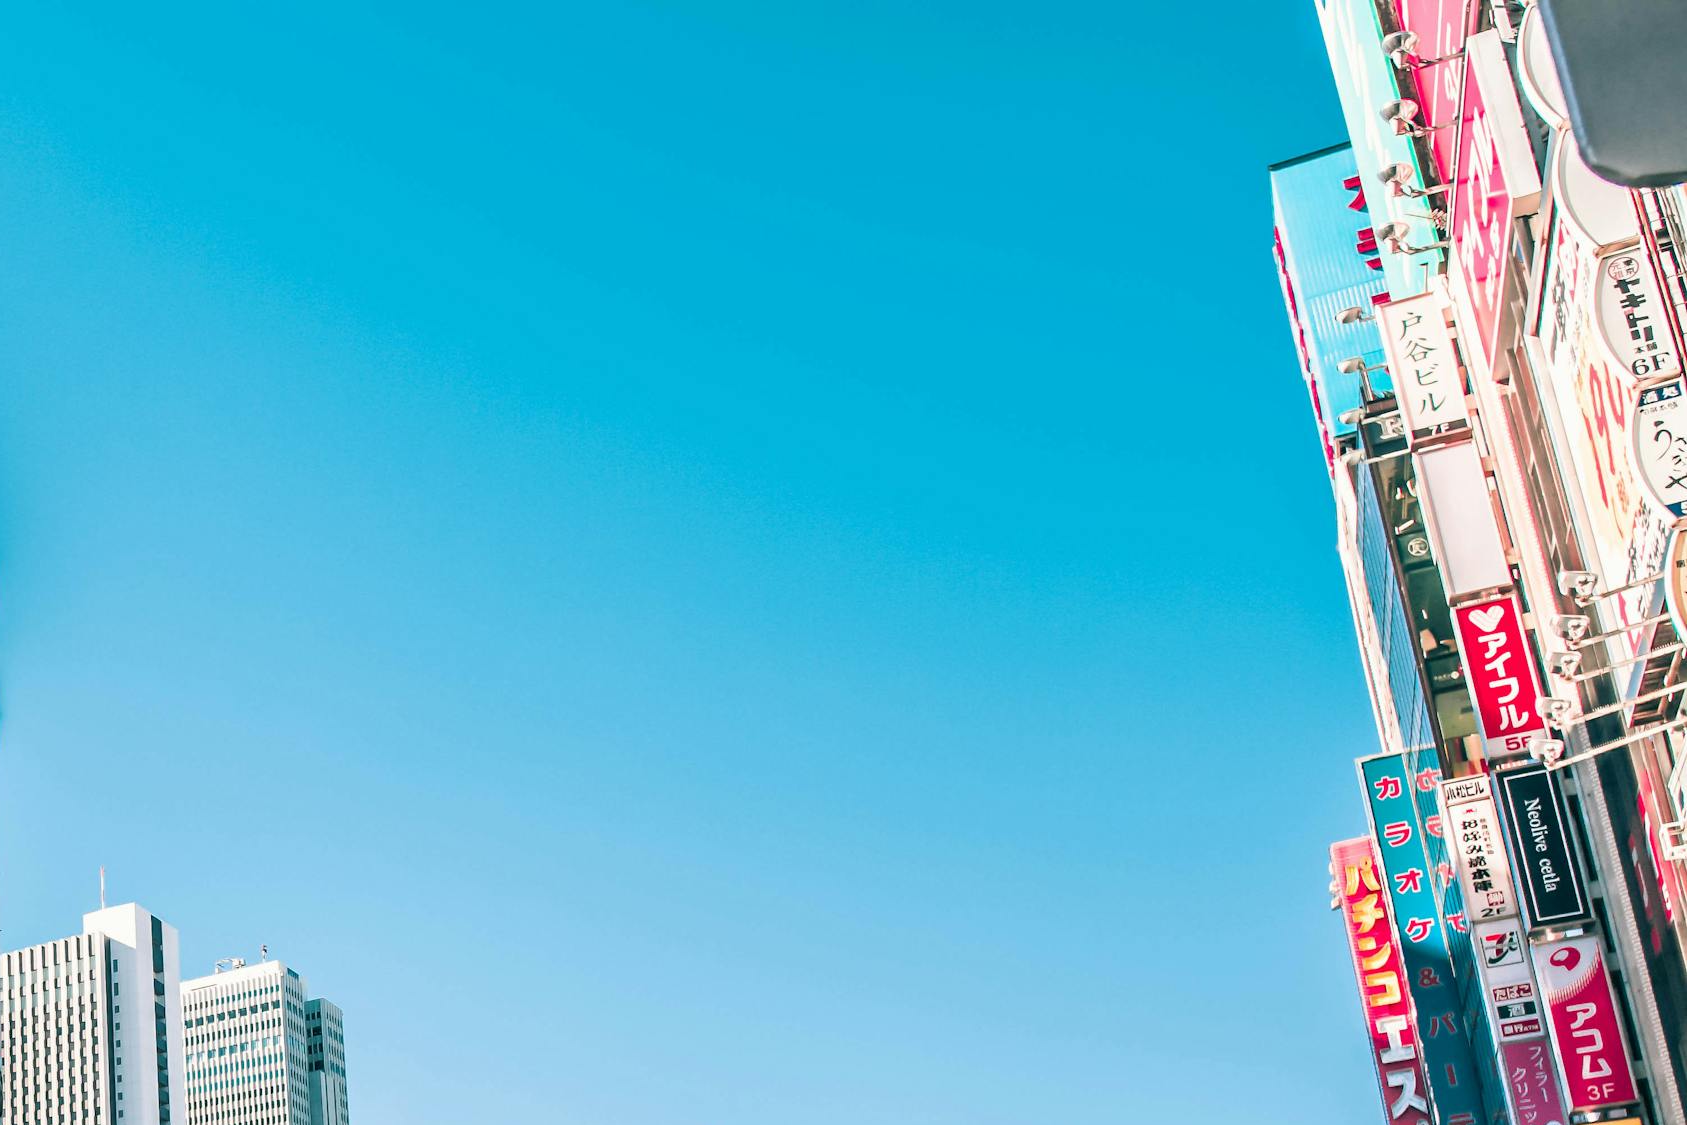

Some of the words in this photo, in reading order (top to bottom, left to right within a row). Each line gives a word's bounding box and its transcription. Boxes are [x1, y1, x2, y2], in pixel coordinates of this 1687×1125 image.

[1399, 310, 1447, 415] 戸谷ビル
[1632, 352, 1670, 376] 6F
[1427, 423, 1451, 436] 7F
[1477, 632, 1530, 732] アイフル
[1505, 735, 1532, 751] 5F
[1446, 781, 1485, 800] 小松ビル
[1524, 797, 1549, 852] Neolive
[1481, 906, 1507, 918] 2F
[1344, 854, 1404, 1008] パチンコ
[1496, 984, 1533, 1000] たばこ
[1566, 1002, 1613, 1080] アコム
[1529, 1046, 1549, 1103] フィラー
[1586, 1083, 1616, 1099] 3F
